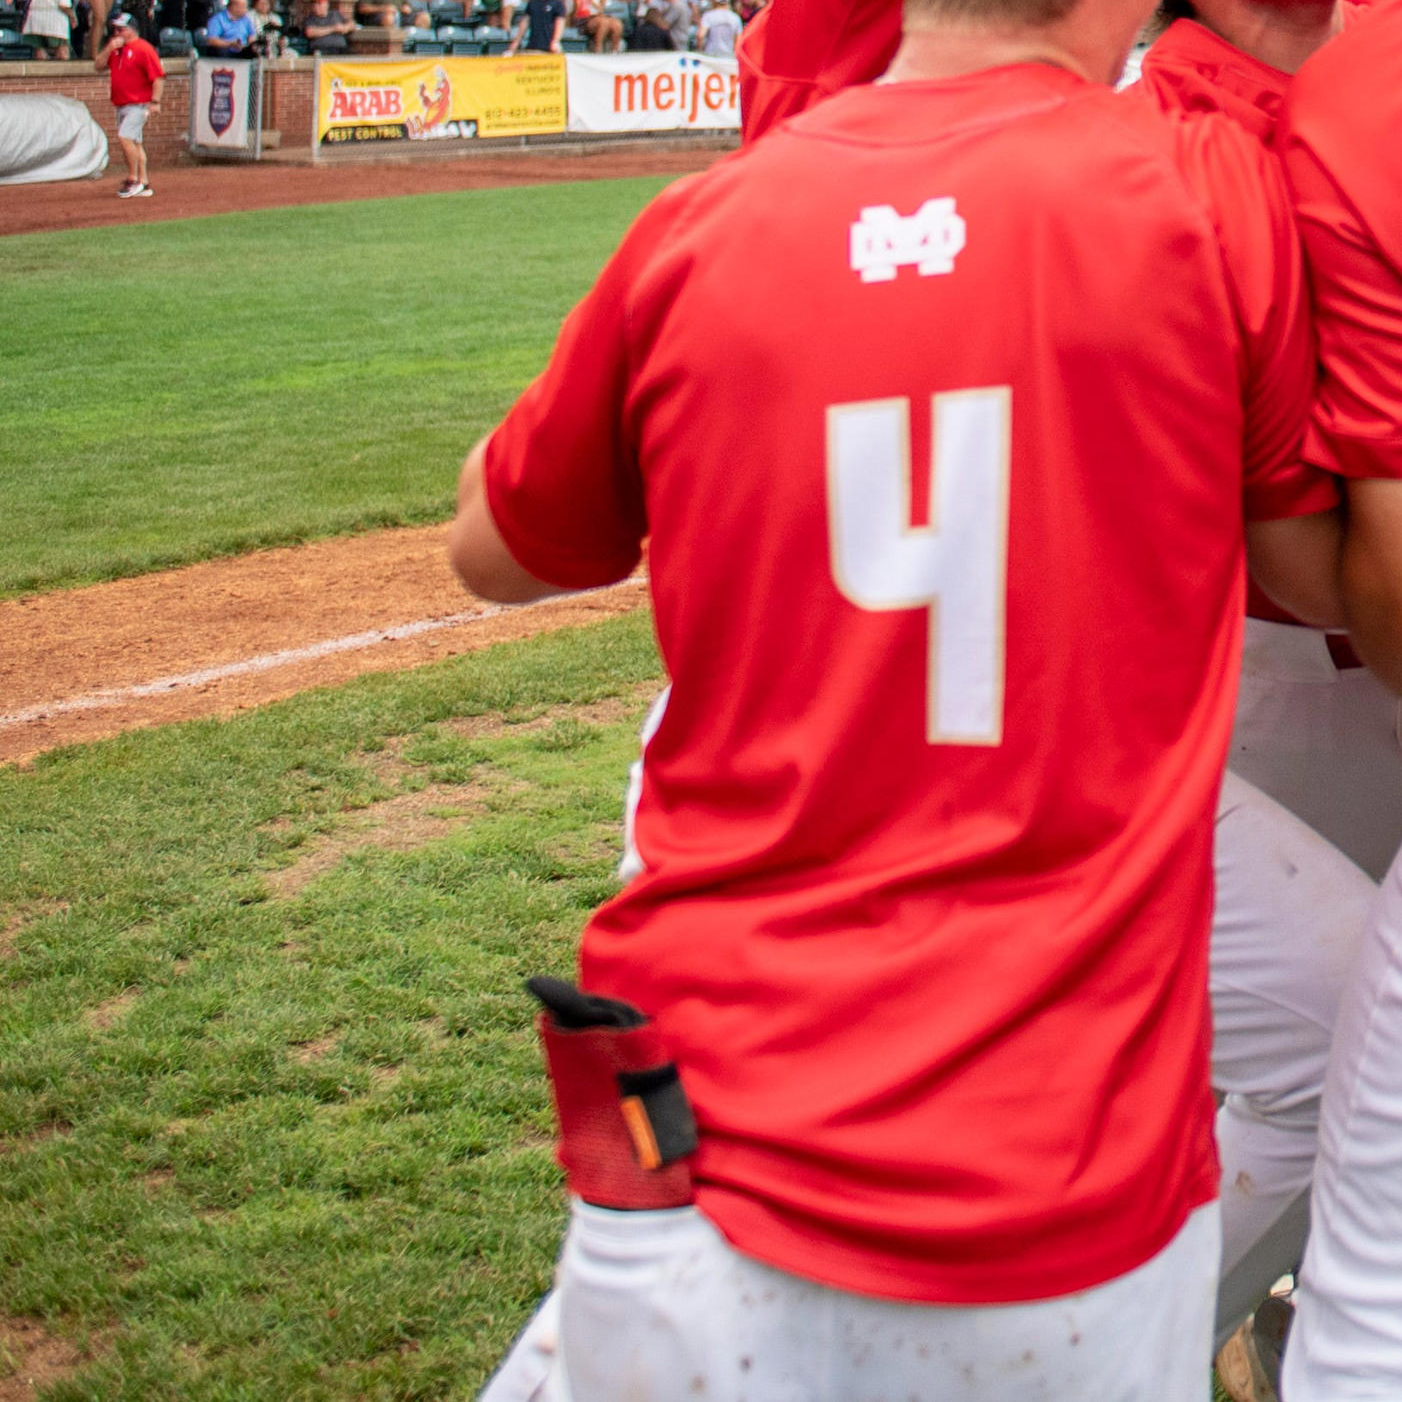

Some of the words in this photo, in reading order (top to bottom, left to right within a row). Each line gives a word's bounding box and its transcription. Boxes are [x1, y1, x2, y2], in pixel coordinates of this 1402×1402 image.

[328, 89, 402, 119] ARAB
[613, 57, 738, 123] meijer
[328, 128, 353, 142] PEST
[355, 125, 403, 140] CONTROL
[825, 384, 1012, 747] 4
